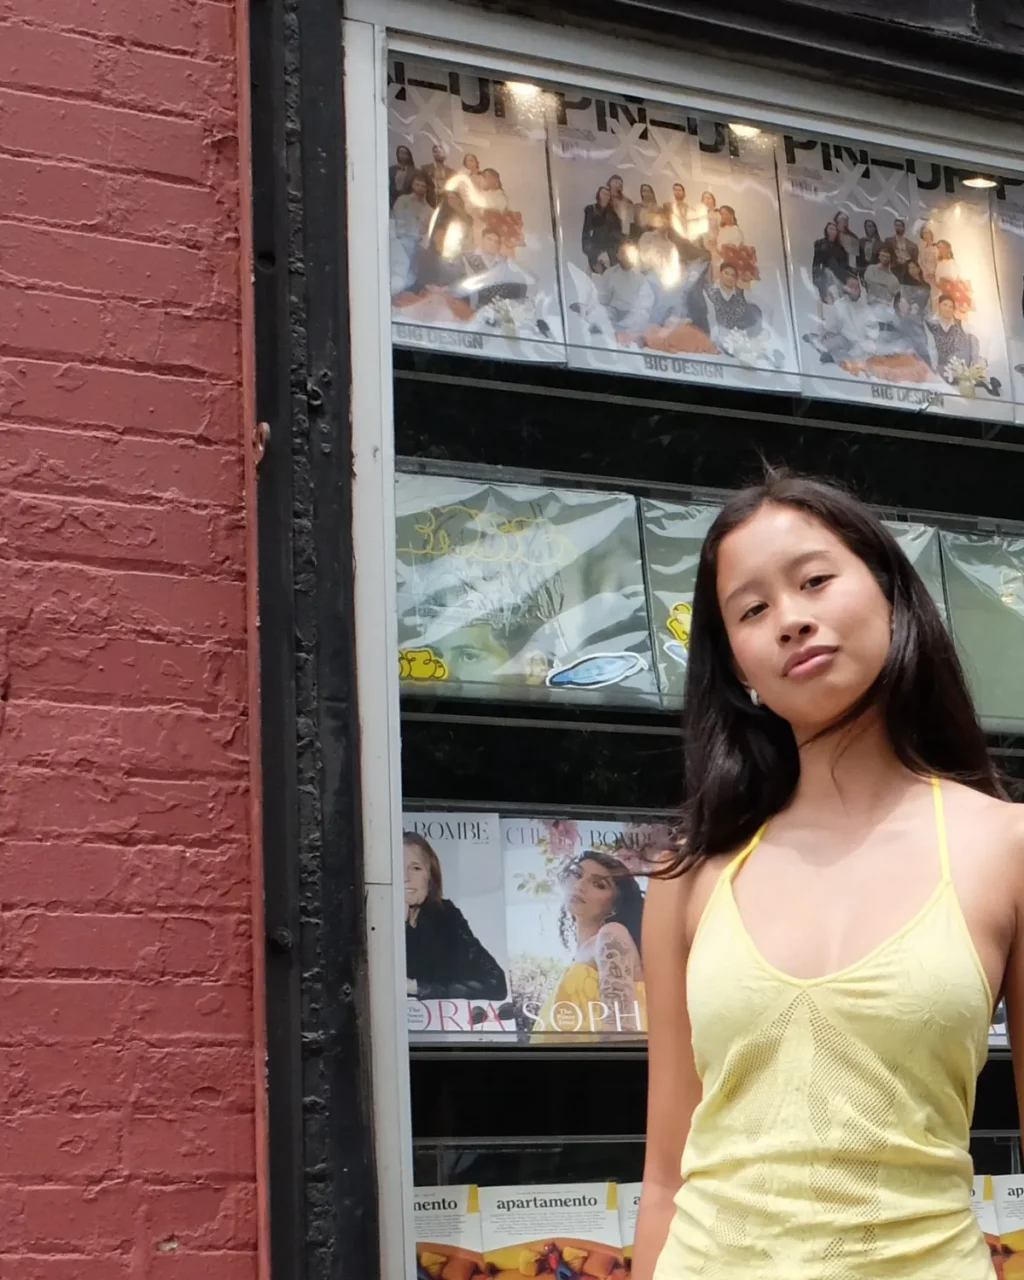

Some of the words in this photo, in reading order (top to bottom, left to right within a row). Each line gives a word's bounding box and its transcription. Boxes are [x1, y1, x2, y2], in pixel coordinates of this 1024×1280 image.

[645, 355, 669, 372] BIG
[672, 359, 725, 380] DESIGN
[871, 385, 893, 401] BIG
[414, 821, 489, 840] BOMBE
[496, 1194, 598, 1212] apartamento
